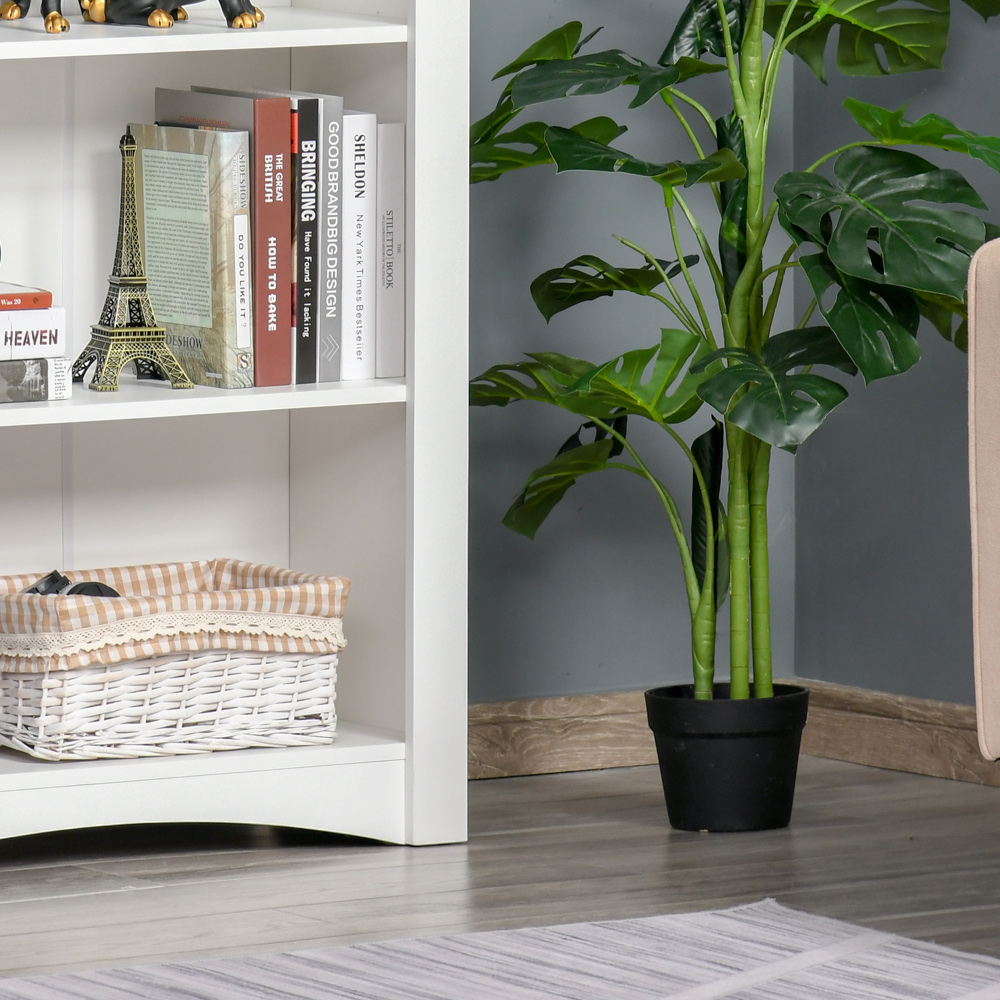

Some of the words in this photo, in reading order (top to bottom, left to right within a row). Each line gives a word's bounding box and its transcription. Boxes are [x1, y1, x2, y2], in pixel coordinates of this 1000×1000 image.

[328, 121, 339, 169] GOOD
[265, 155, 273, 203] BRITISH
[354, 134, 366, 198] SHELDON
[301, 140, 316, 222] BRINGING
[356, 214, 364, 238] New
[238, 235, 244, 250] DO
[268, 236, 276, 269] HOW
[304, 231, 312, 252] Have
[268, 273, 276, 290] TO
[304, 256, 312, 282] Found
[304, 288, 311, 297] it
[326, 257, 338, 317] DESIGN
[240, 308, 246, 318] IT
[268, 294, 276, 331] BAKE
[302, 303, 310, 337] lacking
[4, 329, 58, 347] HEAVEN
[166, 335, 203, 349] DESHOW
